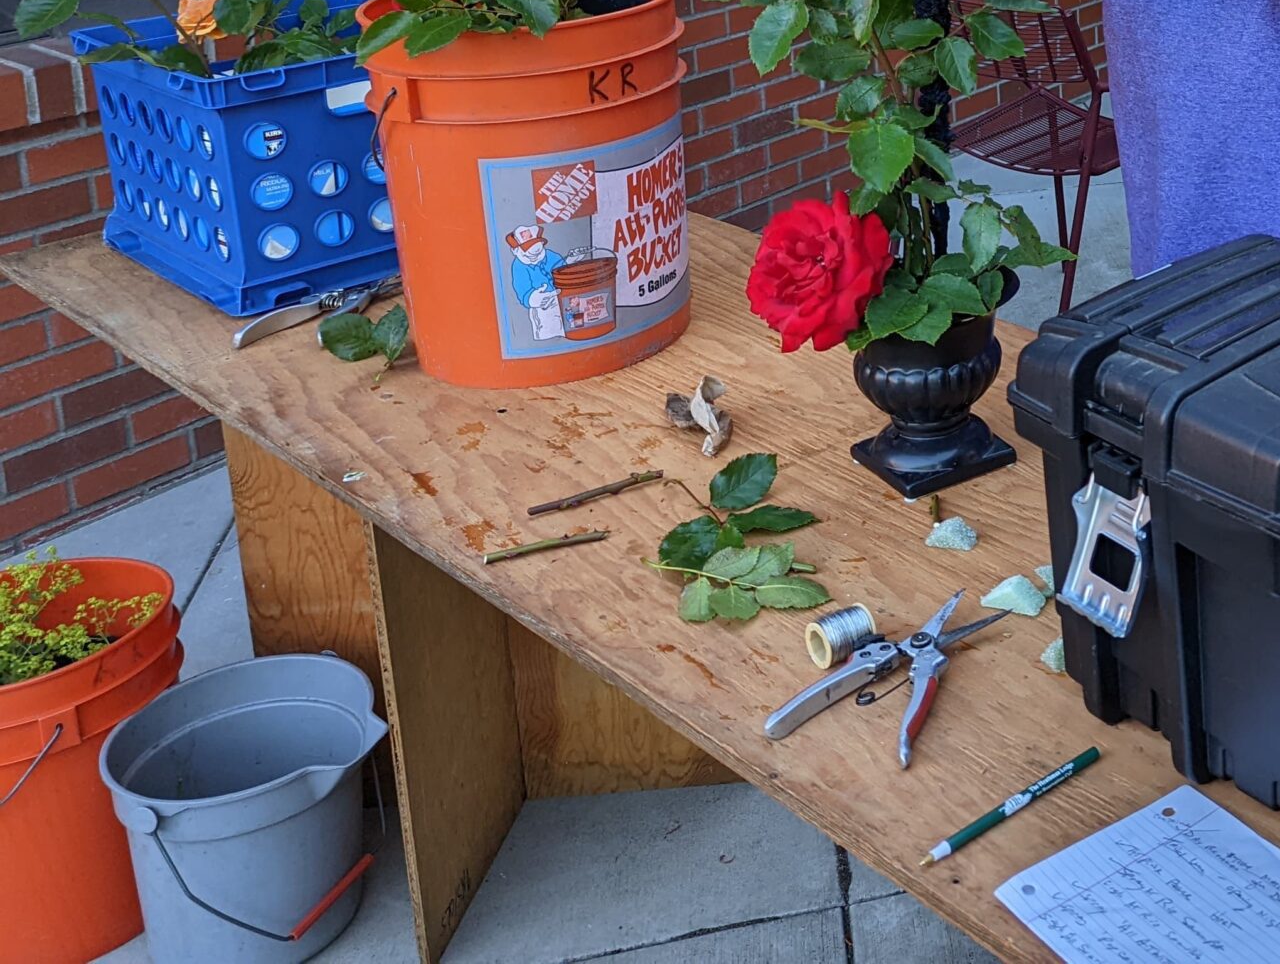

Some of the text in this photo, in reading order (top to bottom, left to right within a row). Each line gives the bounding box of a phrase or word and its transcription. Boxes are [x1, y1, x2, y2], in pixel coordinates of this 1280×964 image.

[535, 163, 594, 224] HOME
[538, 171, 566, 196] THE
[559, 180, 596, 221] DEPOT
[626, 224, 683, 284] BUCKET
[638, 268, 677, 298] 5 Gallons
